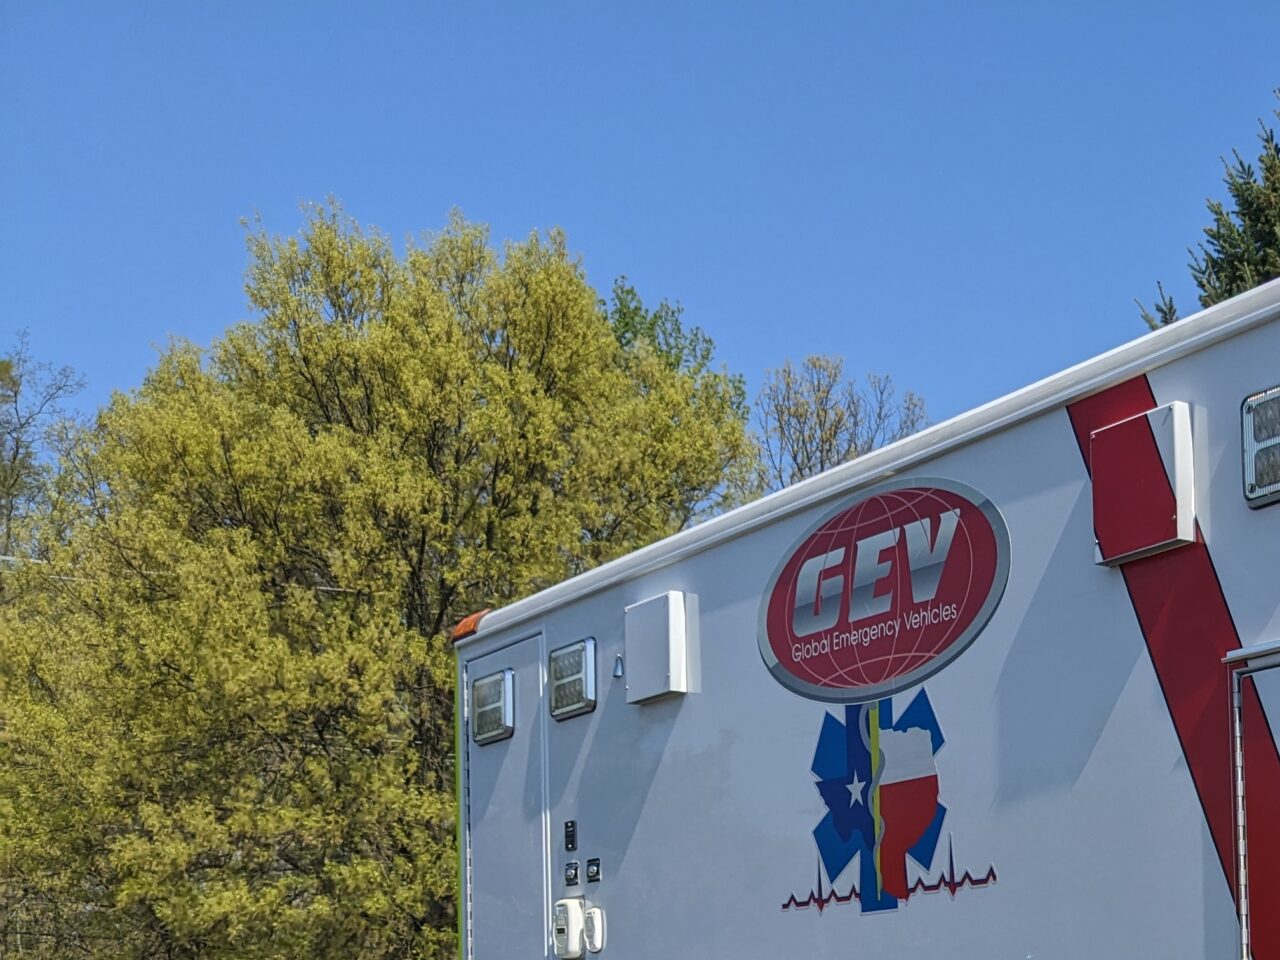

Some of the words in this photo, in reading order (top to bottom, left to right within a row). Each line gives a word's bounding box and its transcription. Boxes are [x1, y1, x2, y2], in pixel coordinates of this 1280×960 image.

[792, 508, 961, 638] GEV
[792, 635, 830, 662] Global
[833, 619, 901, 651] Emergency
[903, 603, 957, 631] Vehicles
